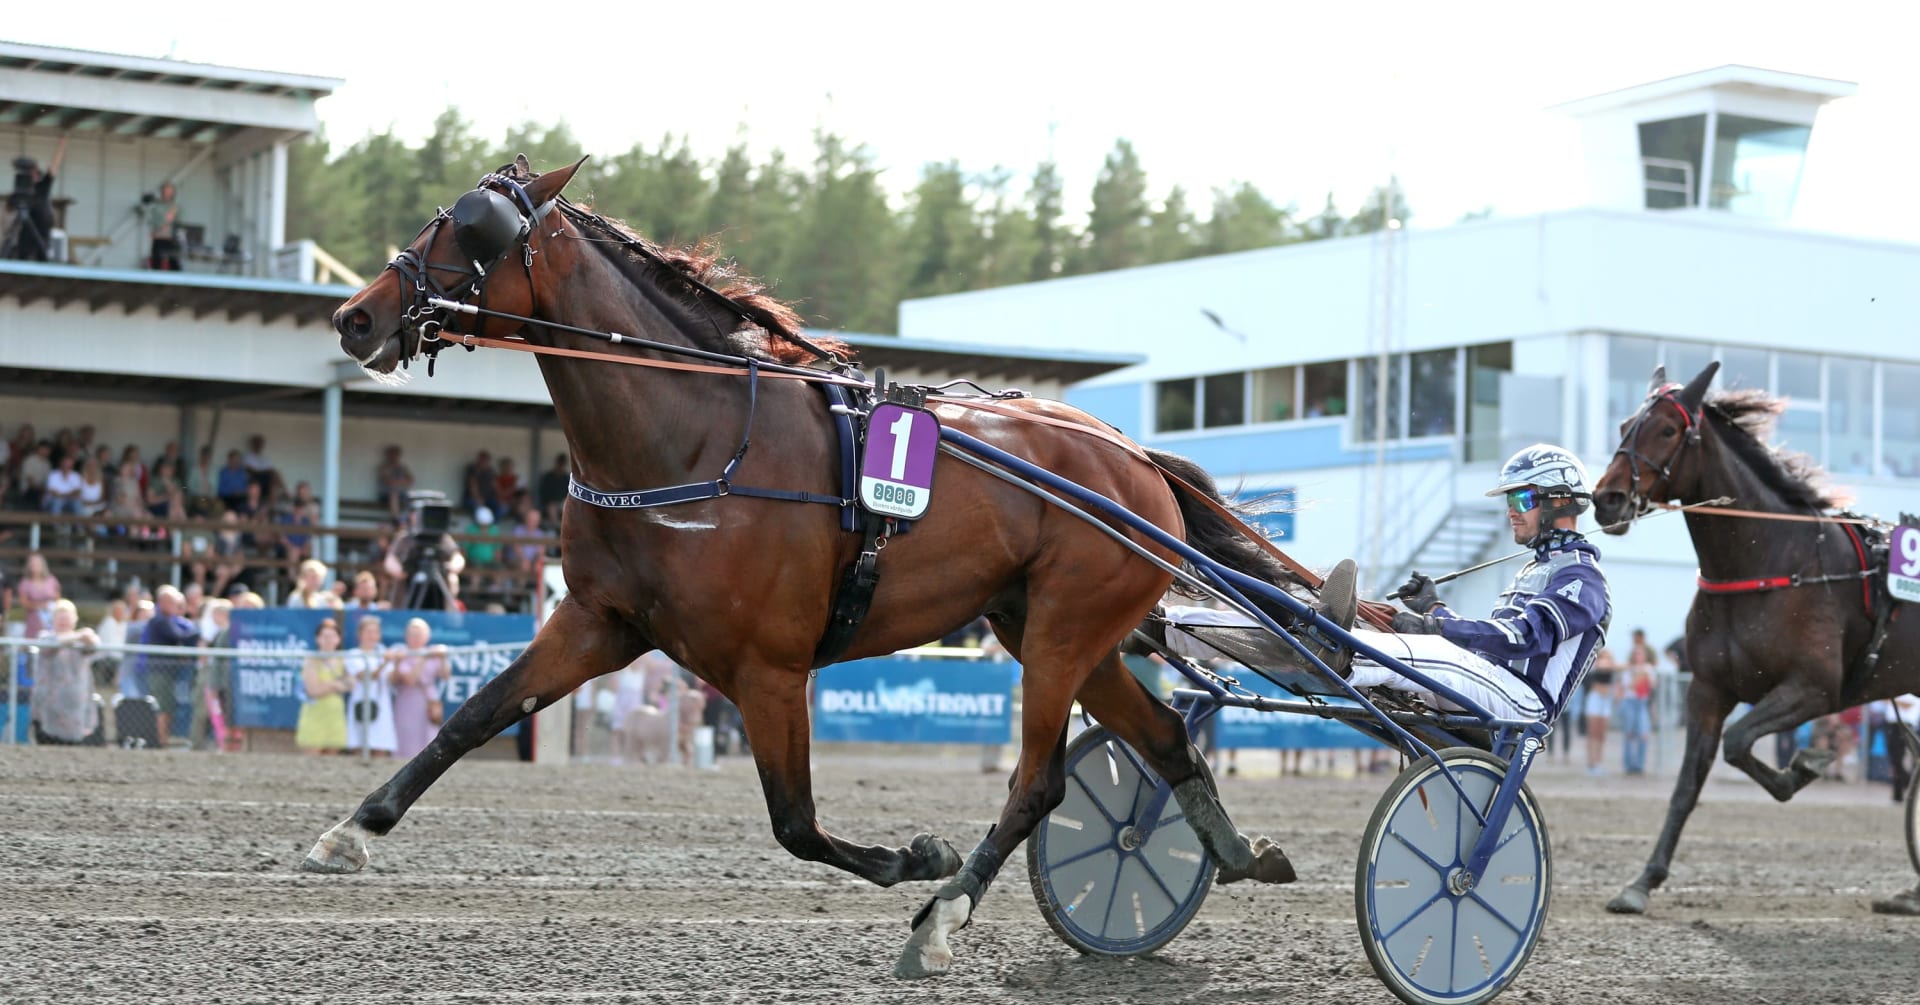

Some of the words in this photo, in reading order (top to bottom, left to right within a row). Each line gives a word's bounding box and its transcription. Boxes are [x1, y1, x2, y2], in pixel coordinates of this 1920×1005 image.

[890, 411, 913, 480] 1
[590, 493, 641, 506] LAVEC
[1900, 528, 1920, 577] 9
[1557, 579, 1583, 604] A
